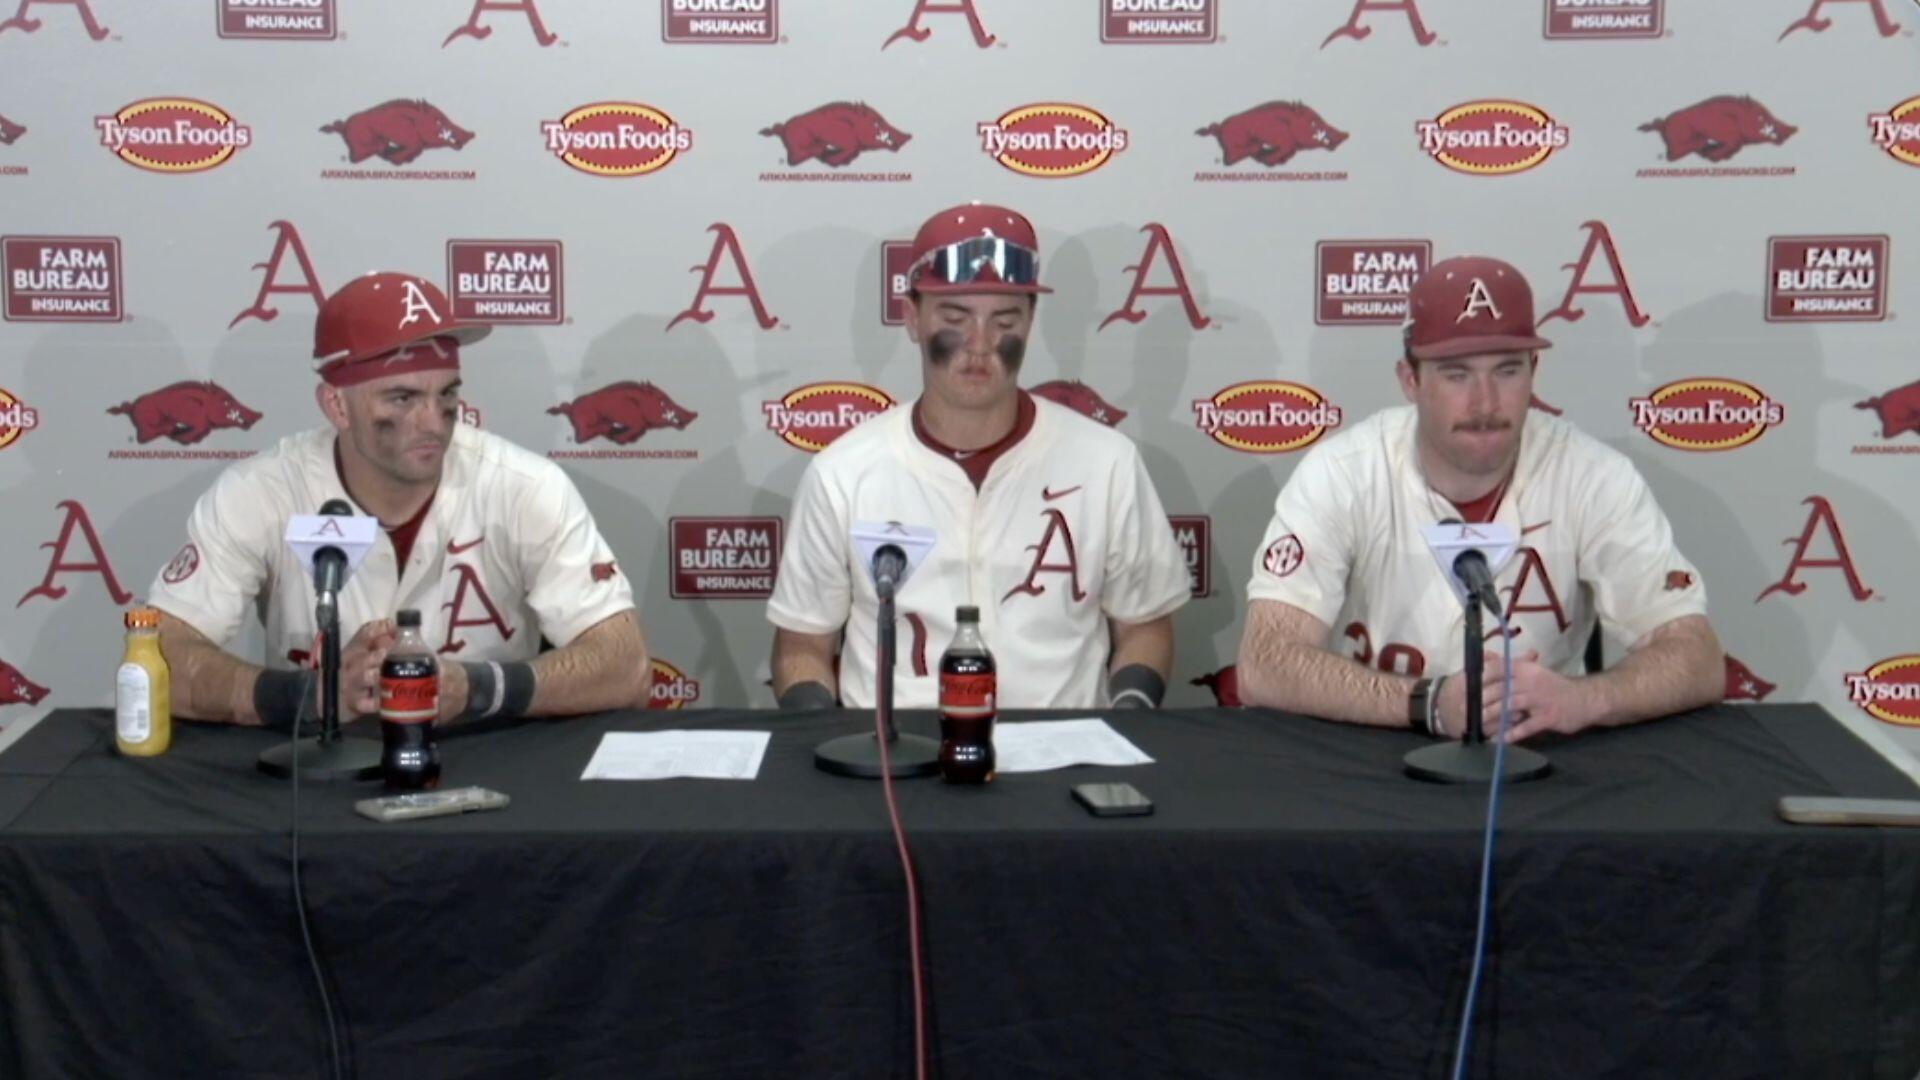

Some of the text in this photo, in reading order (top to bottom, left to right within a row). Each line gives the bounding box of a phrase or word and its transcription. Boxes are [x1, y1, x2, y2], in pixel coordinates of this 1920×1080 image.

[245, 14, 324, 29] INSURANCE
[690, 19, 766, 33] INSURANCE
[1127, 19, 1204, 33] INSURANCE
[1571, 14, 1651, 29] INSURANCE
[98, 119, 248, 150] Tyson Foods
[544, 124, 690, 156] Tyson Foods
[980, 125, 1126, 156] Tyson Foods
[1419, 121, 1566, 155] Tyson Foods
[40, 248, 107, 268] FARM
[484, 251, 550, 272] FARM
[1353, 252, 1418, 272] FARM
[1806, 247, 1874, 268] FARM
[13, 269, 109, 291] BUREAU
[229, 220, 326, 331] A
[458, 273, 552, 293] BUREAU
[665, 223, 779, 332] A
[1098, 223, 1213, 332] A
[1537, 220, 1653, 330] A
[1778, 269, 1875, 290] BUREAU
[32, 298, 110, 312] INSURANCE
[399, 281, 442, 330] A
[475, 302, 551, 315] INSURANCE
[1342, 302, 1408, 315] INSURAN
[1456, 278, 1502, 324] A
[1793, 297, 1874, 312] INSURANCE
[765, 403, 835, 433] Tyson
[1195, 401, 1340, 433] Tyson Foods
[1632, 400, 1780, 430] Tyson Foods
[706, 528, 770, 548] FARM
[1756, 496, 1876, 604] A
[17, 500, 135, 608] A
[681, 548, 771, 569] BUREAU
[1001, 508, 1087, 604] A
[697, 576, 771, 590] INSURANCE
[1482, 547, 1573, 642] A
[437, 563, 515, 655] A
[649, 676, 697, 700] ods
[1847, 676, 1920, 706] Tyson
